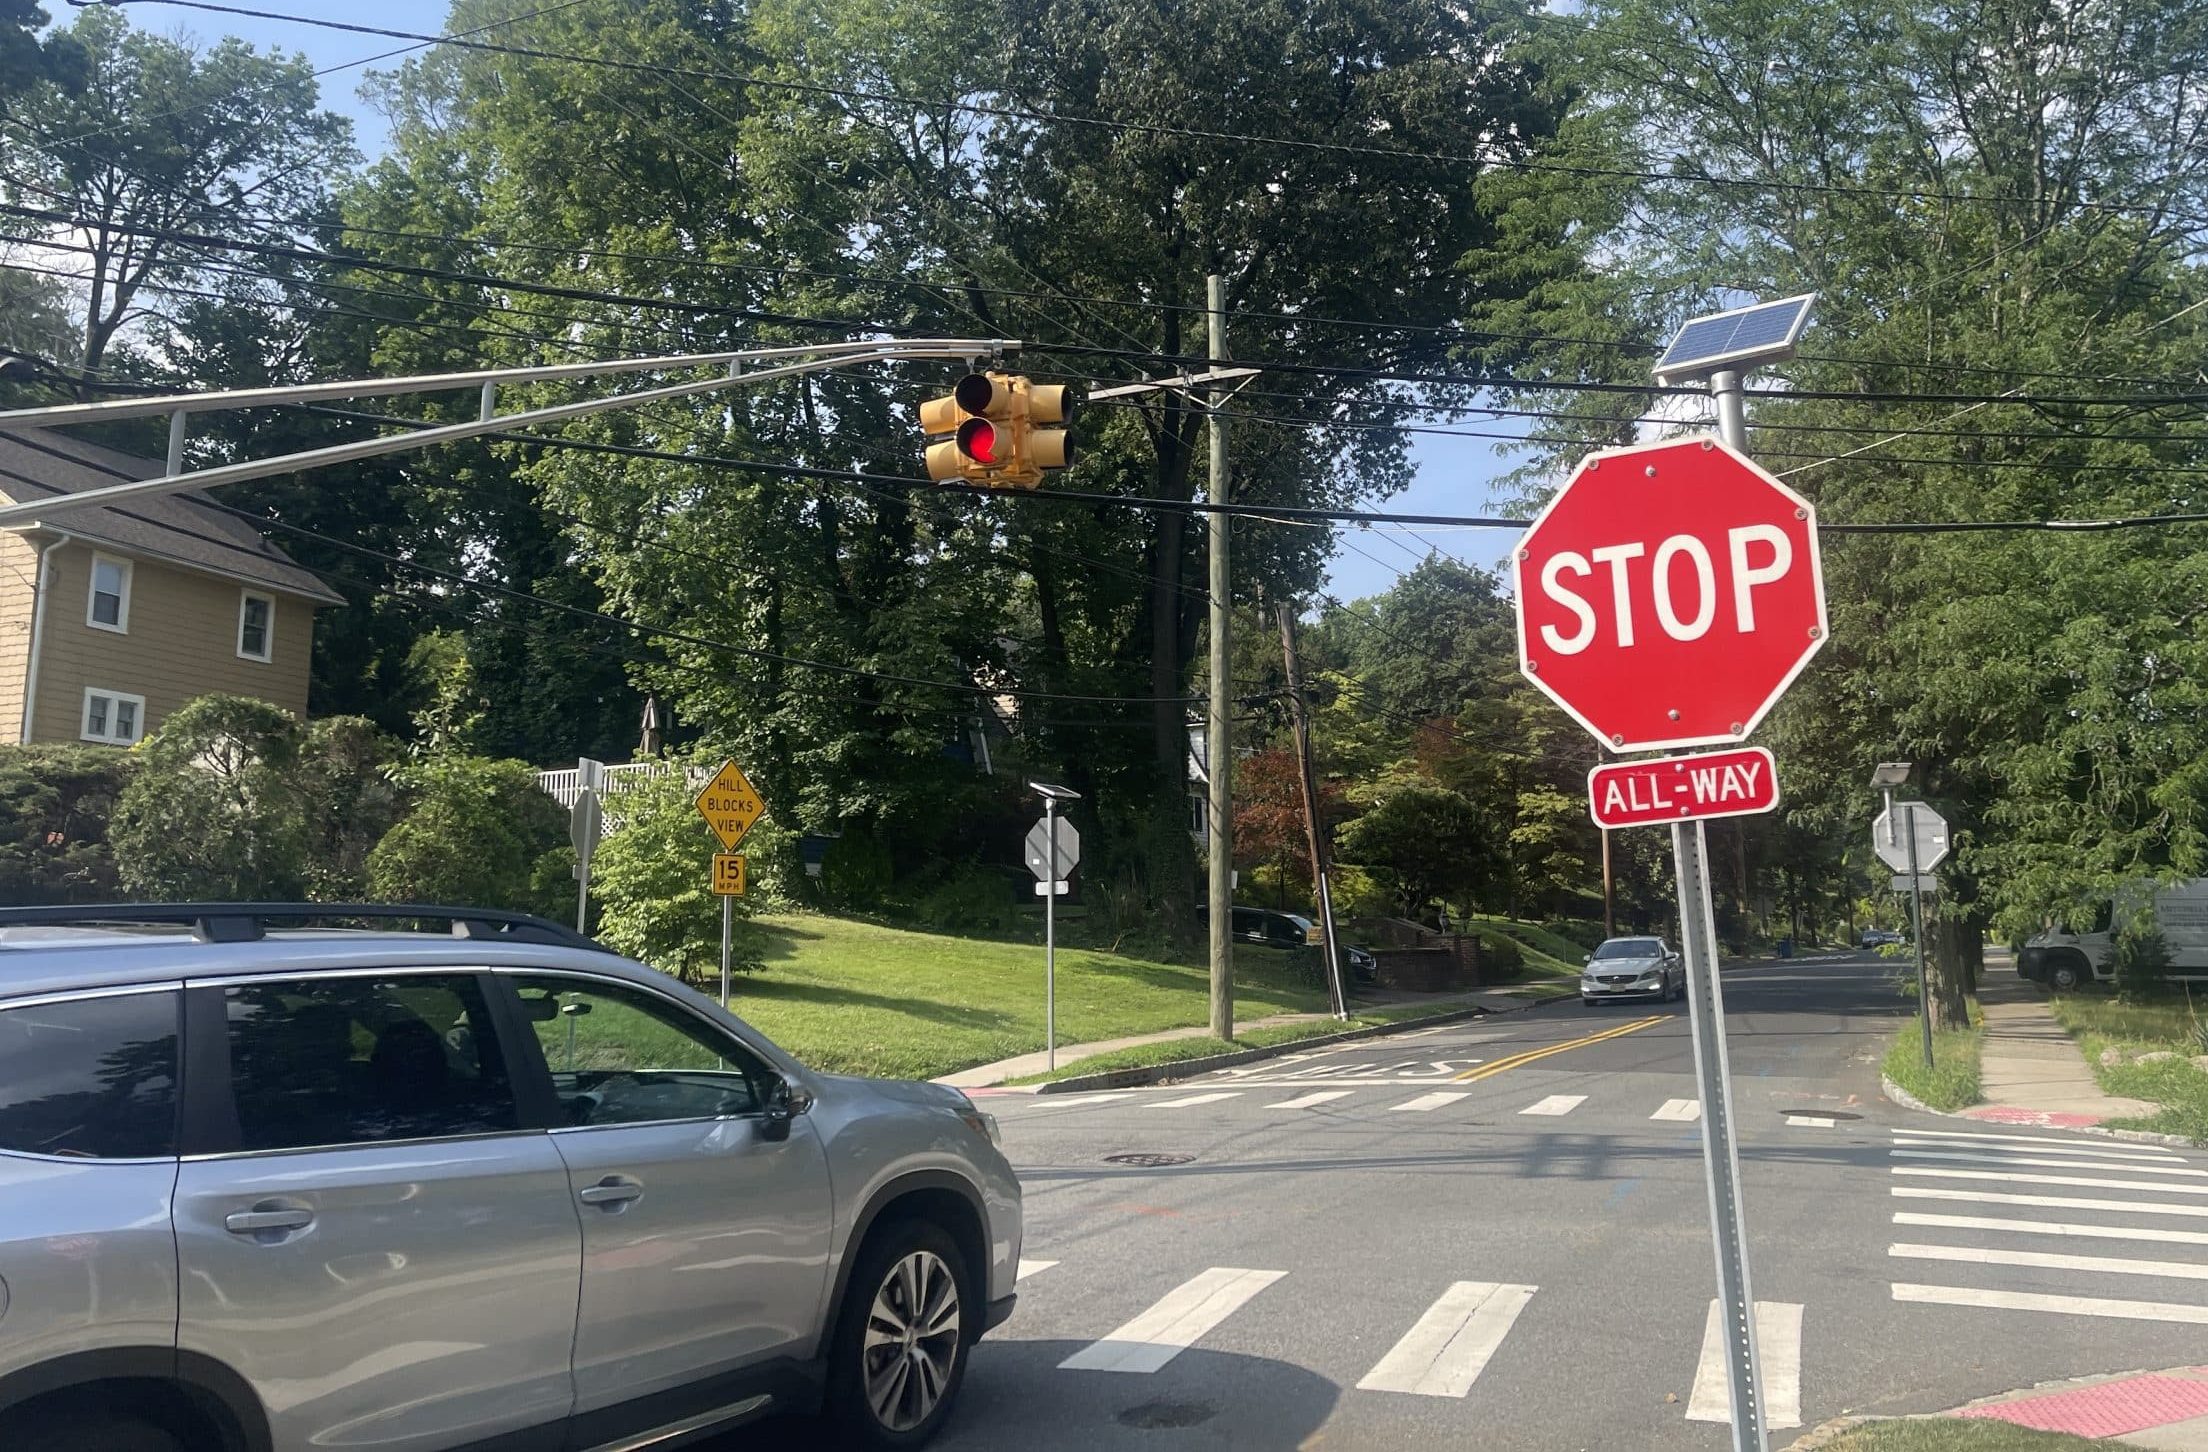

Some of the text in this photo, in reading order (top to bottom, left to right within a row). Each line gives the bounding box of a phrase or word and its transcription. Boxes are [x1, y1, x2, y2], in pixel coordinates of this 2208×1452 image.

[1540, 523, 1793, 656] STOP
[718, 779, 743, 792] HILL
[1603, 761, 1762, 815] ALL-WAY
[708, 798, 753, 812] BLOCKS
[717, 819, 744, 832] VIEW
[720, 860, 739, 880] 15
[719, 882, 740, 890] MPH
